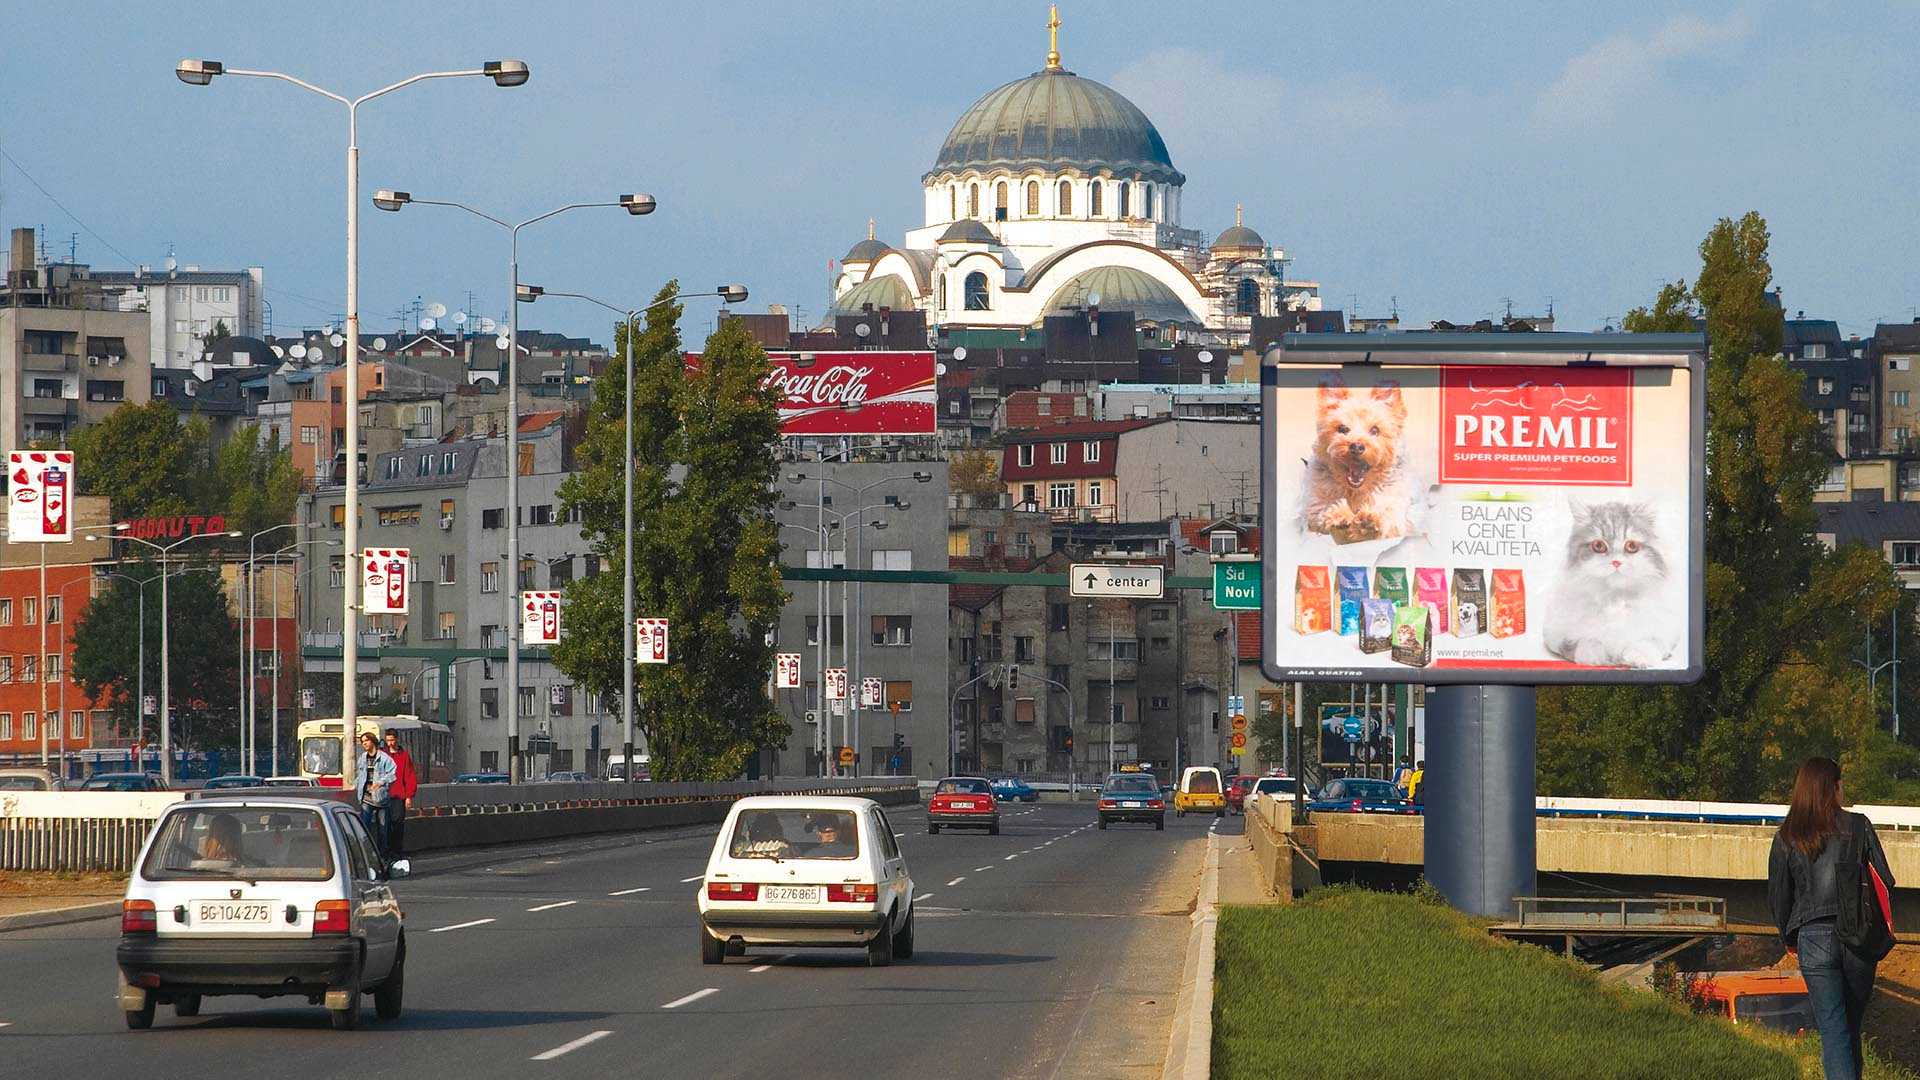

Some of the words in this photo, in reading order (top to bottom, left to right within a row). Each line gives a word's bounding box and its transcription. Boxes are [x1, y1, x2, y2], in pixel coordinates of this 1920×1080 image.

[1454, 453, 1492, 462] SUPER
[1494, 453, 1551, 463] PREMIUM
[1553, 455, 1617, 464] PETFOODS
[1461, 505, 1533, 522] BALANS
[1467, 522, 1516, 539] CENE
[1521, 523, 1526, 539] I
[1452, 540, 1542, 556] KVALITETA
[1225, 566, 1245, 581] Šid
[1106, 576, 1150, 588] centar
[1225, 585, 1255, 598] Novi
